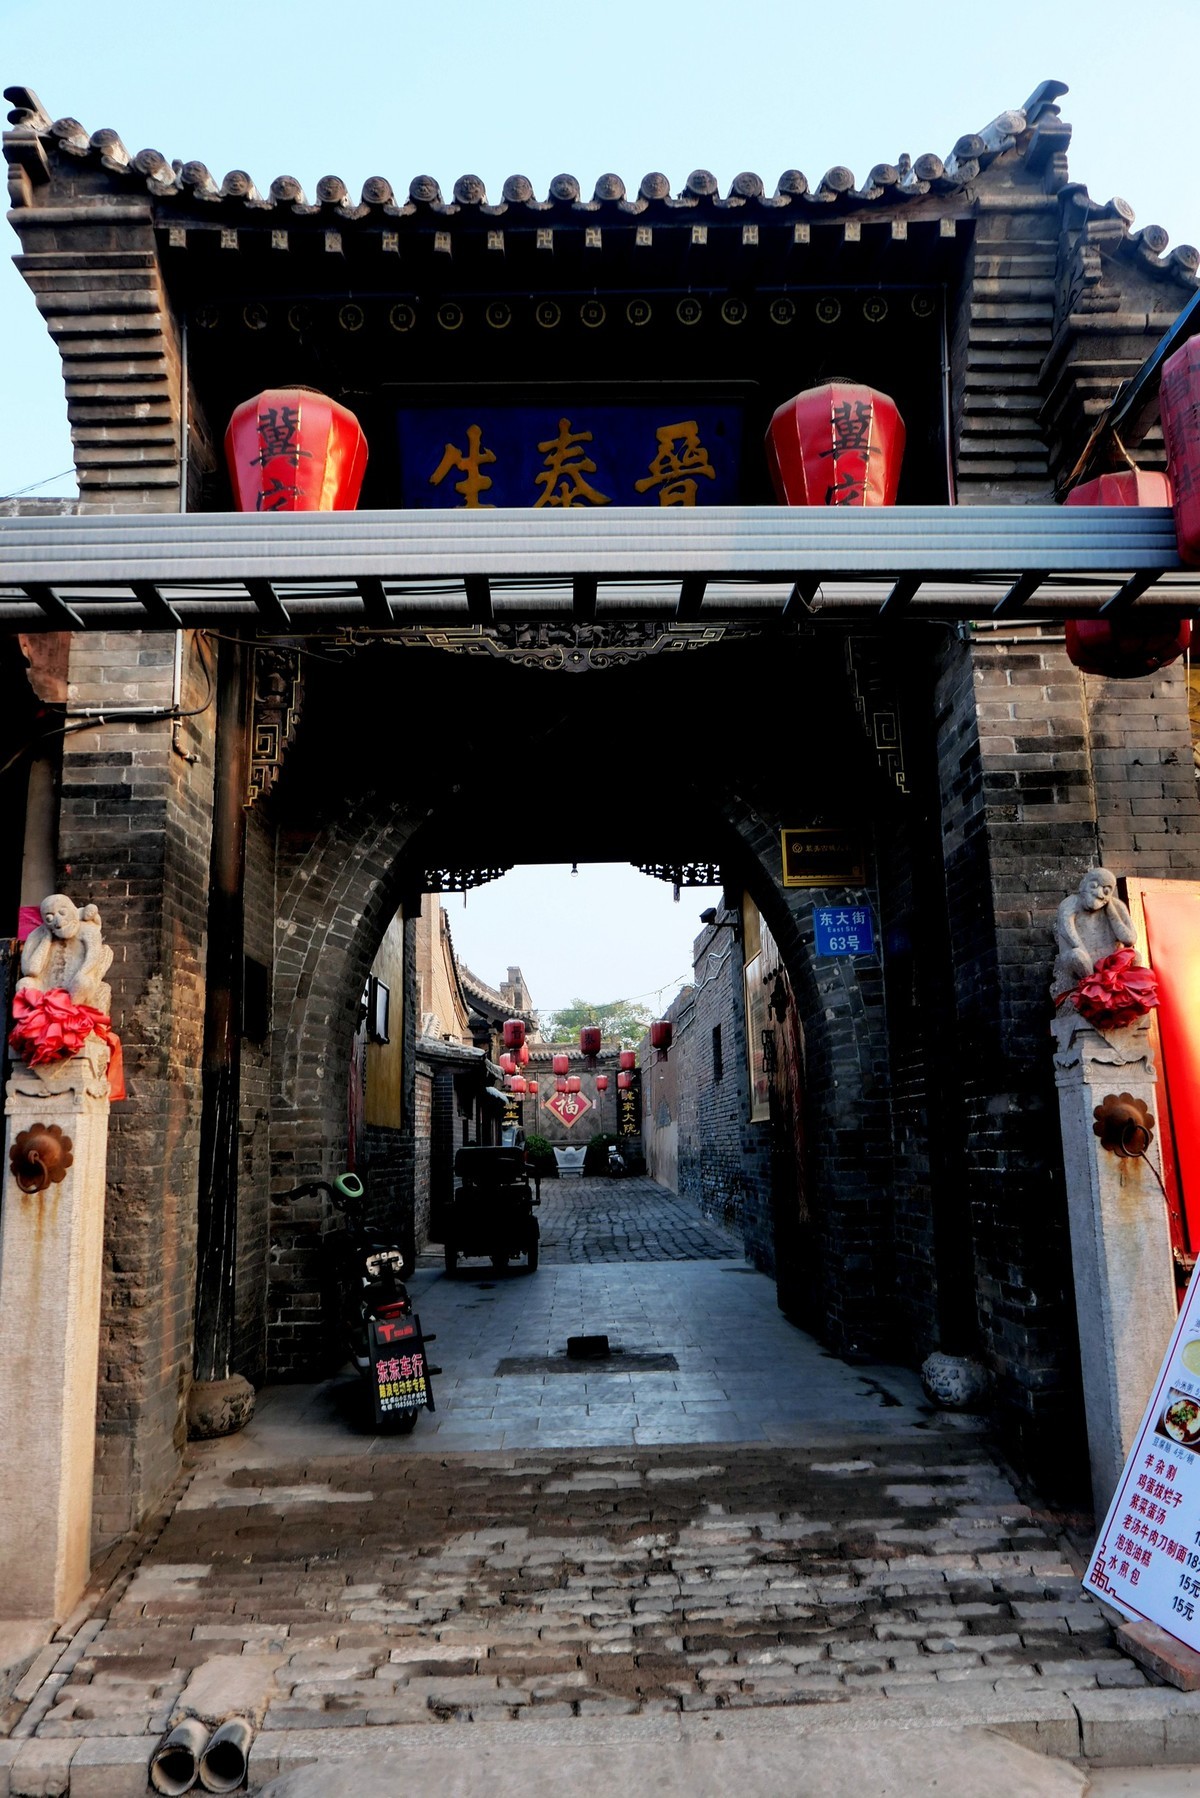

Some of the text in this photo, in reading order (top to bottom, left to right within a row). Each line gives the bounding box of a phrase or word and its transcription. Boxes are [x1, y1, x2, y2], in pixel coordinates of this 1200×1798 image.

[820, 910, 865, 926] 东大街
[830, 935, 860, 951] 63号
[555, 1092, 579, 1116] 福
[376, 1354, 423, 1383] 东东车行
[1129, 1493, 1167, 1525] 紫菜蛋汤
[1114, 1533, 1200, 1598] 泡泡油糕 15元
[1107, 1554, 1195, 1621] 水煎包 15元
